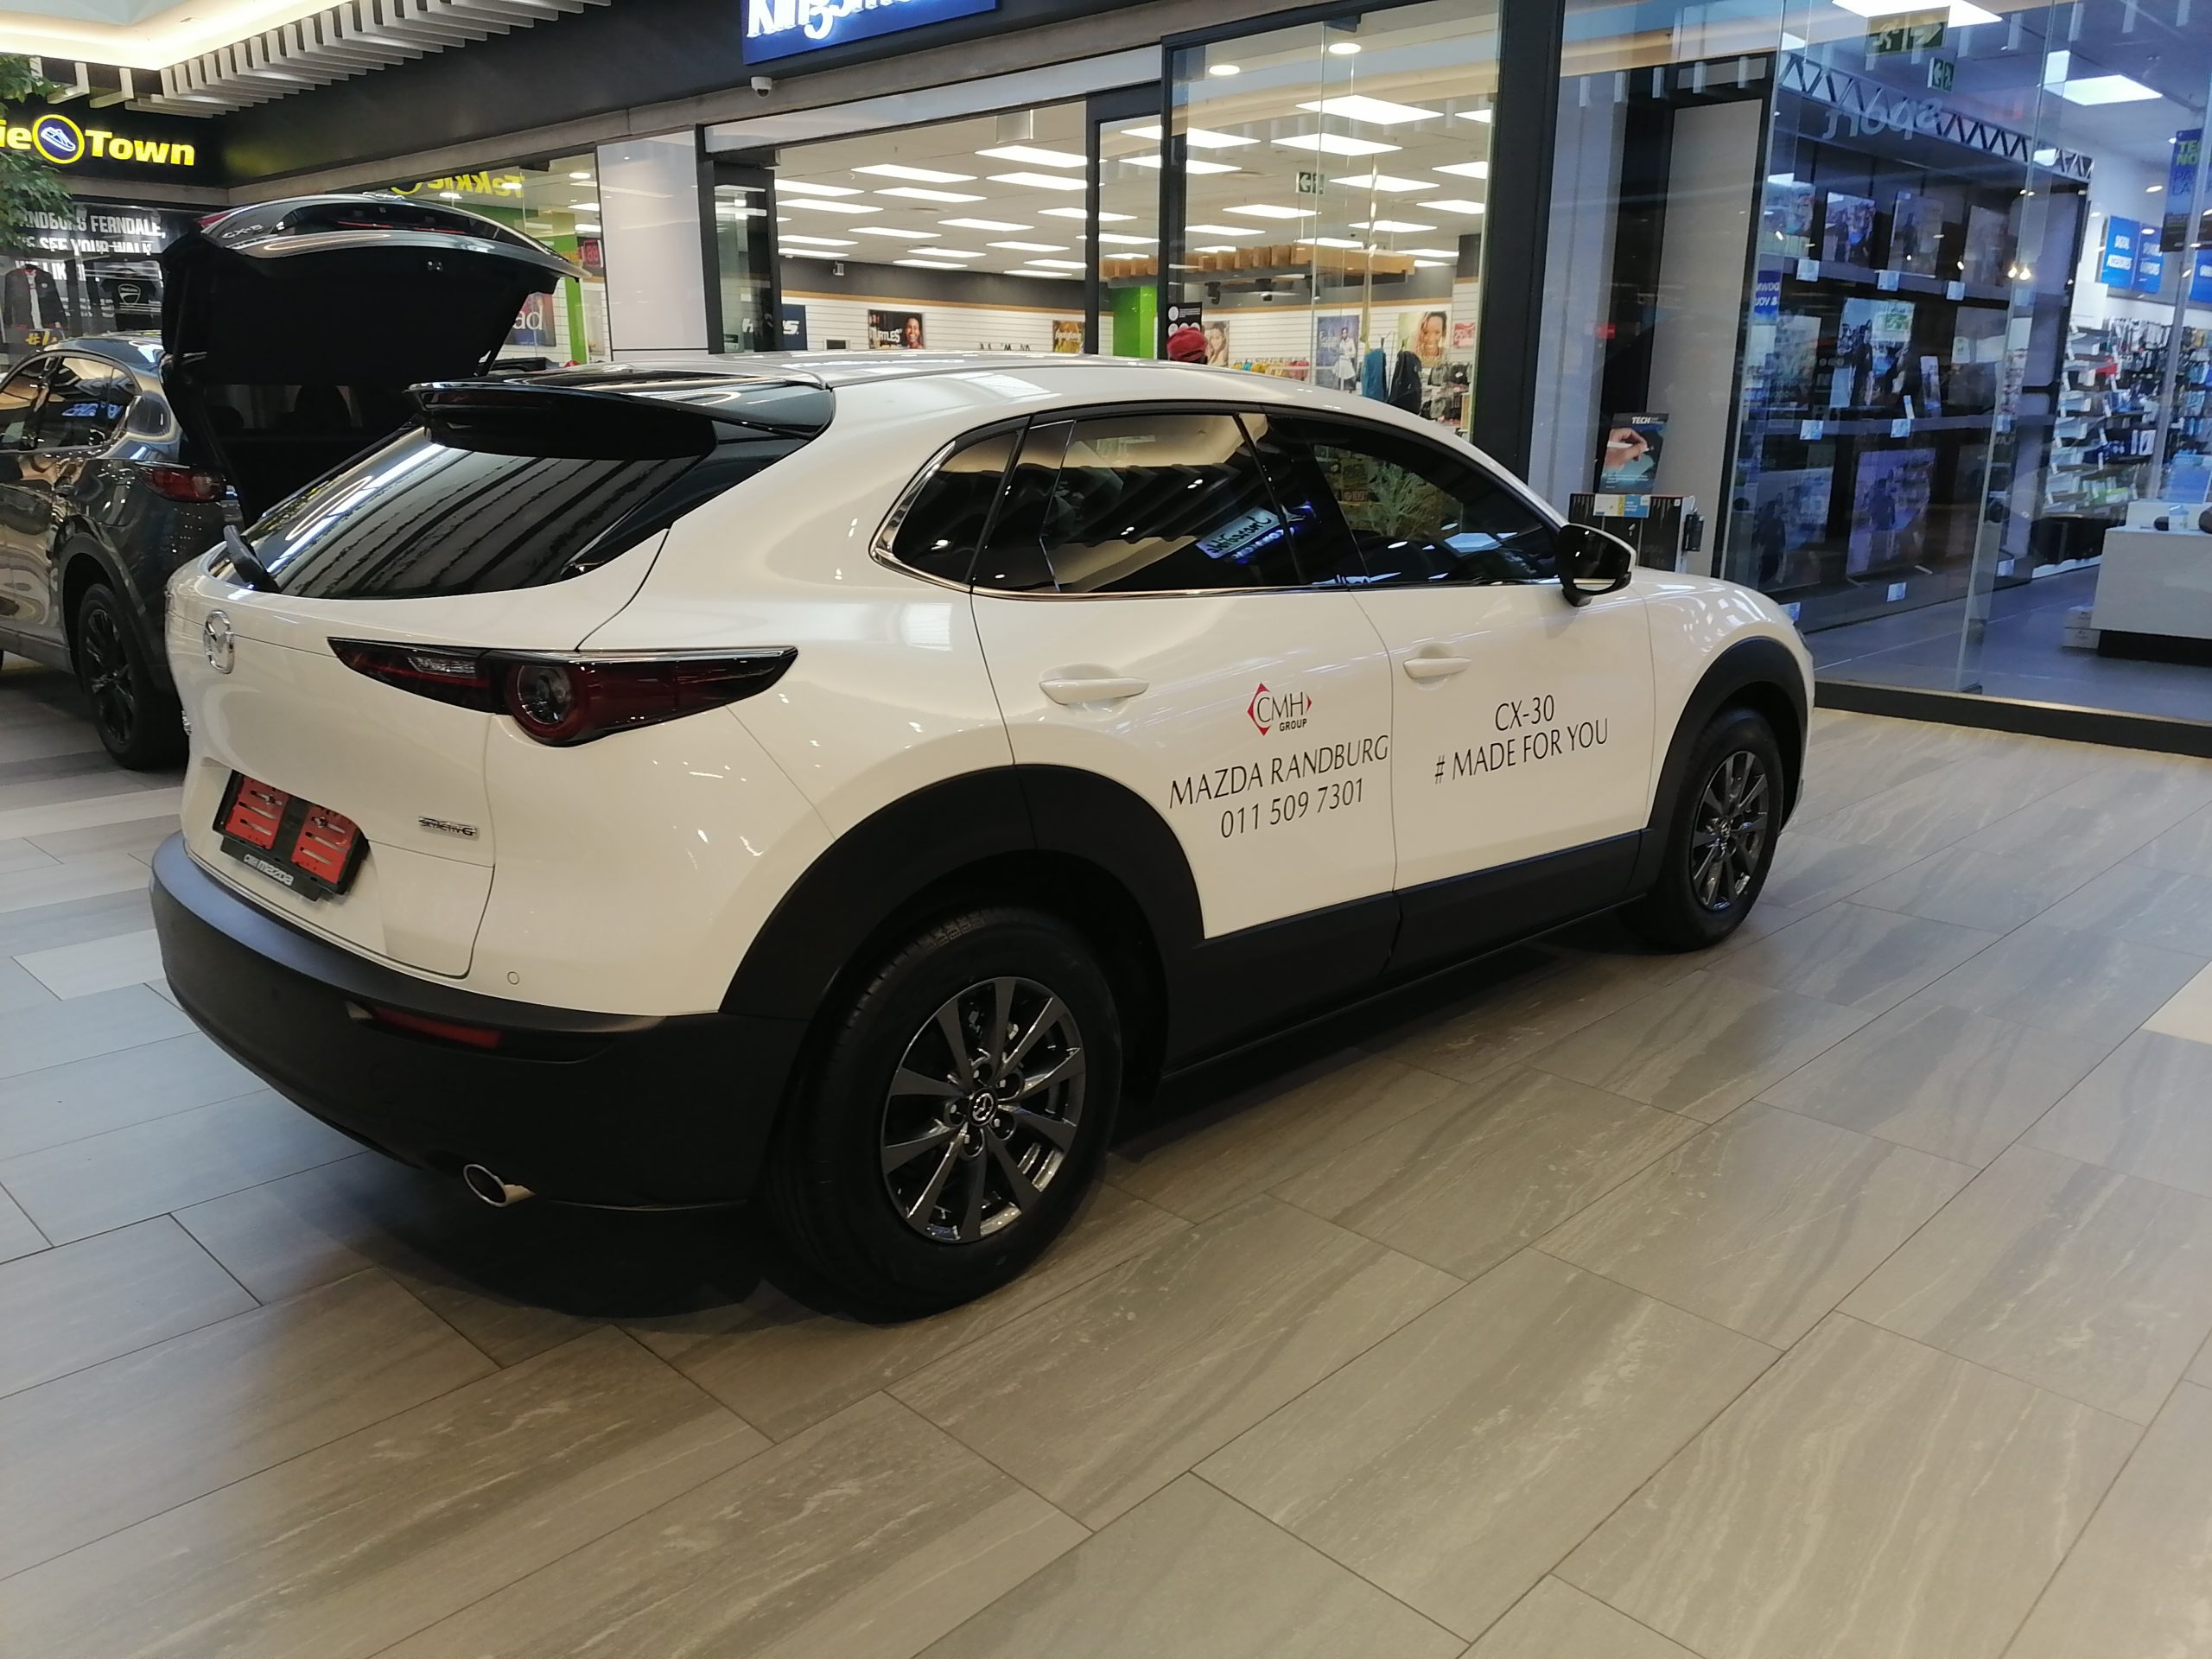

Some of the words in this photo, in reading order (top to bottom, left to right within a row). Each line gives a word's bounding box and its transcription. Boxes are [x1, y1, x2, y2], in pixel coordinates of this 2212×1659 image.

[85, 129, 195, 167] Town
[90, 215, 166, 238] FERNDALE,
[1256, 691, 1304, 722] CMH
[1279, 718, 1307, 732] GROUP
[1495, 695, 1554, 731] CX-30
[1452, 739, 1516, 780] MADE
[1523, 729, 1562, 762] FOR
[1567, 717, 1608, 751] YOU
[1169, 762, 1262, 809] MAZDA
[1270, 734, 1389, 785] RANDBURG
[1221, 804, 1259, 838] 011
[1270, 791, 1309, 825] 509
[1317, 778, 1363, 813] 7301
